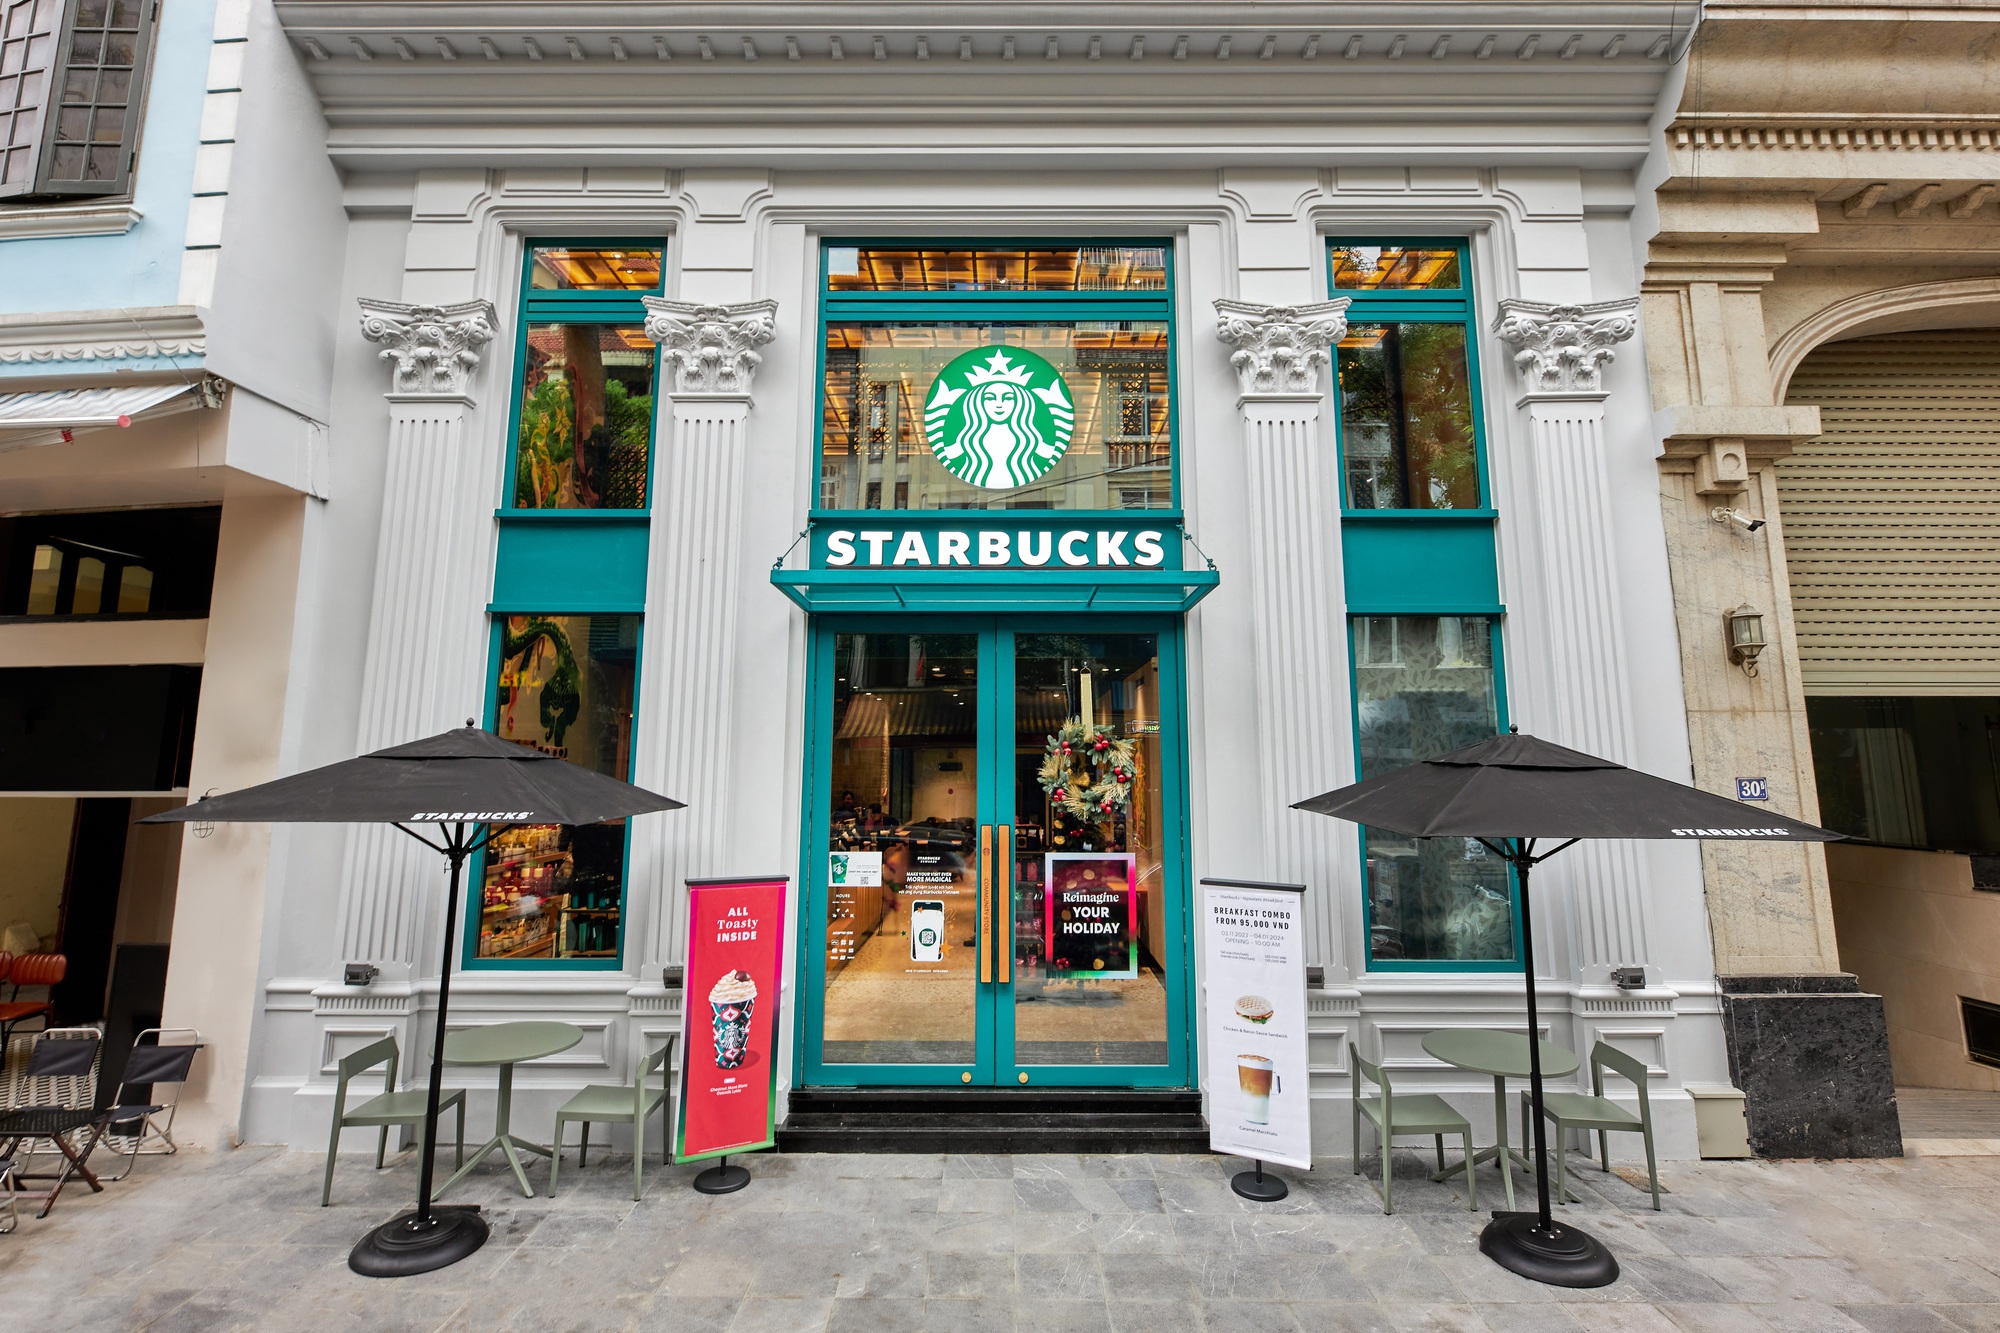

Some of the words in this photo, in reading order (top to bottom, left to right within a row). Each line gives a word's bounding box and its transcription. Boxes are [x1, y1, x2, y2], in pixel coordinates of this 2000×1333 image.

[826, 531, 1164, 566] STARBUCKS
[410, 812, 530, 821] STARBUCKS
[1671, 828, 1789, 837] STARBUCKS
[1063, 892, 1120, 904] Reimagine
[727, 906, 748, 917] ALL
[1073, 907, 1110, 918] YOUR
[1214, 907, 1258, 917] BREAKFAST
[1262, 910, 1290, 919] COMBO
[717, 918, 759, 930] Toasty
[1063, 922, 1120, 934] HOLIDAY
[1216, 917, 1236, 925] FROM
[1240, 919, 1269, 928] 95,000
[717, 931, 757, 942] INSIDE
